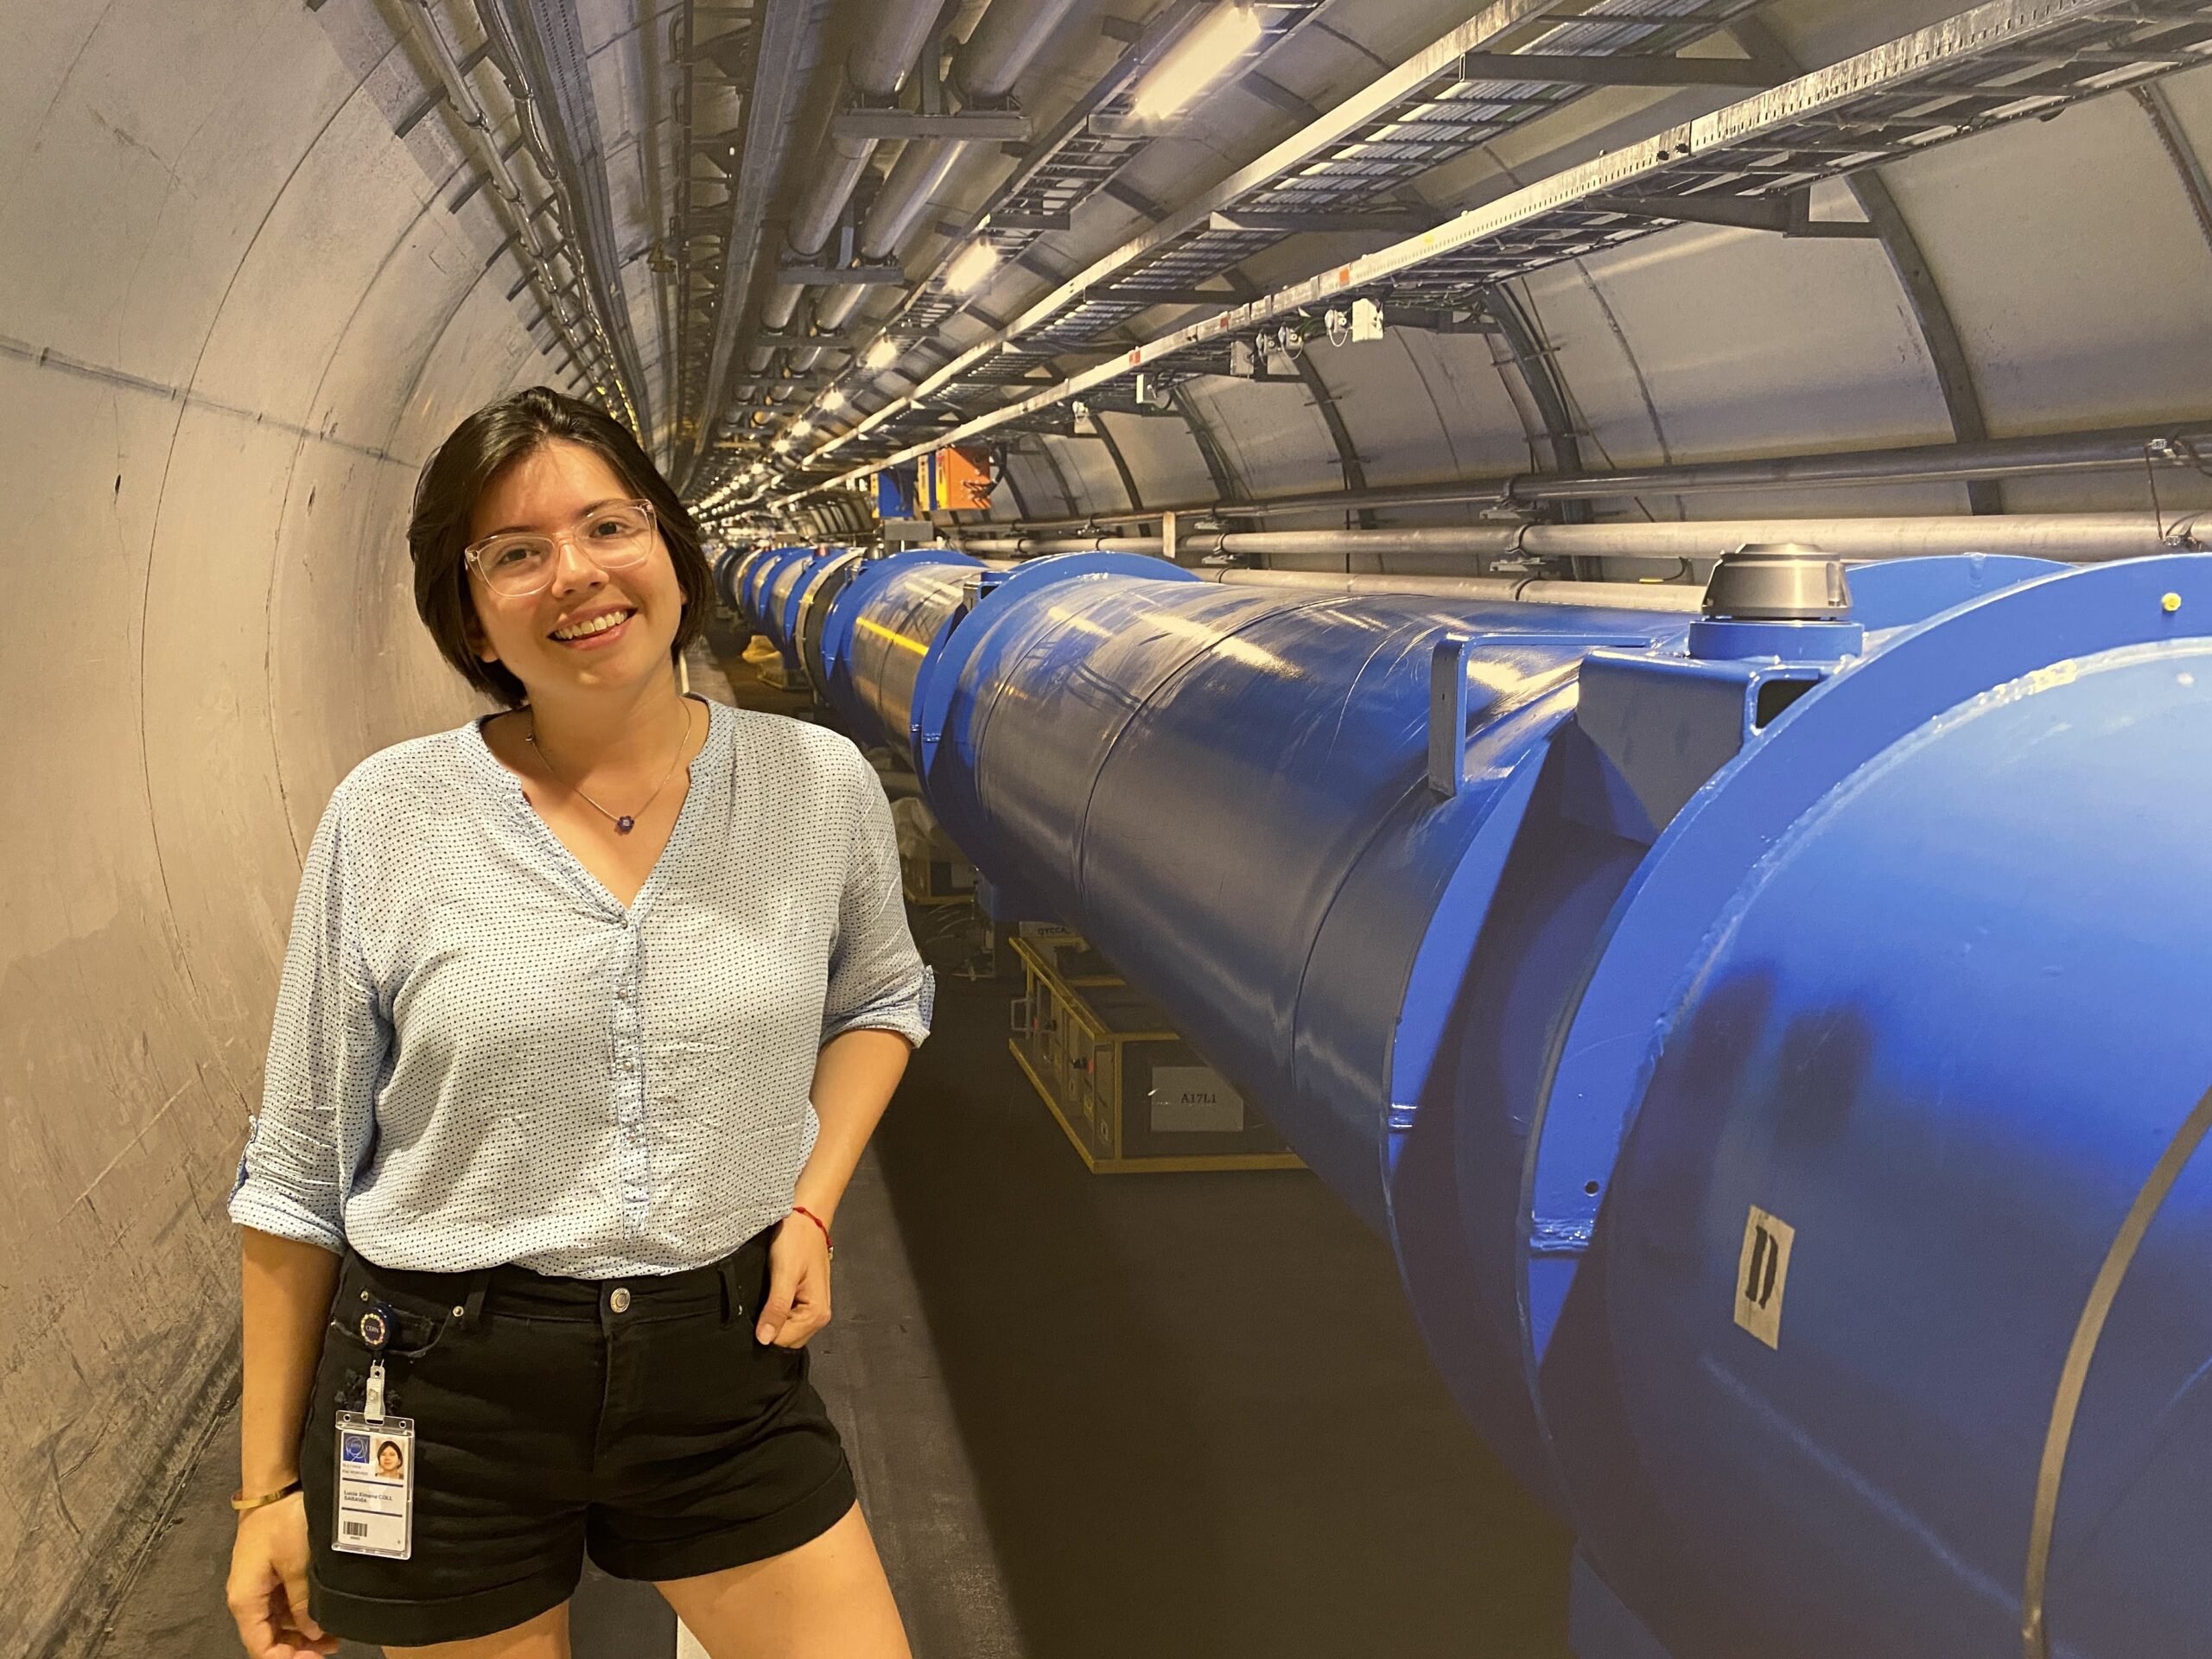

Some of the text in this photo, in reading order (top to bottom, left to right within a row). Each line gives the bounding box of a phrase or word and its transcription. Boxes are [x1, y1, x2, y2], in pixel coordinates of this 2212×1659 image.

[1180, 1093, 1217, 1104] A17L1
[1745, 1224, 1779, 1310] D
[365, 1325, 379, 1333] CERN
